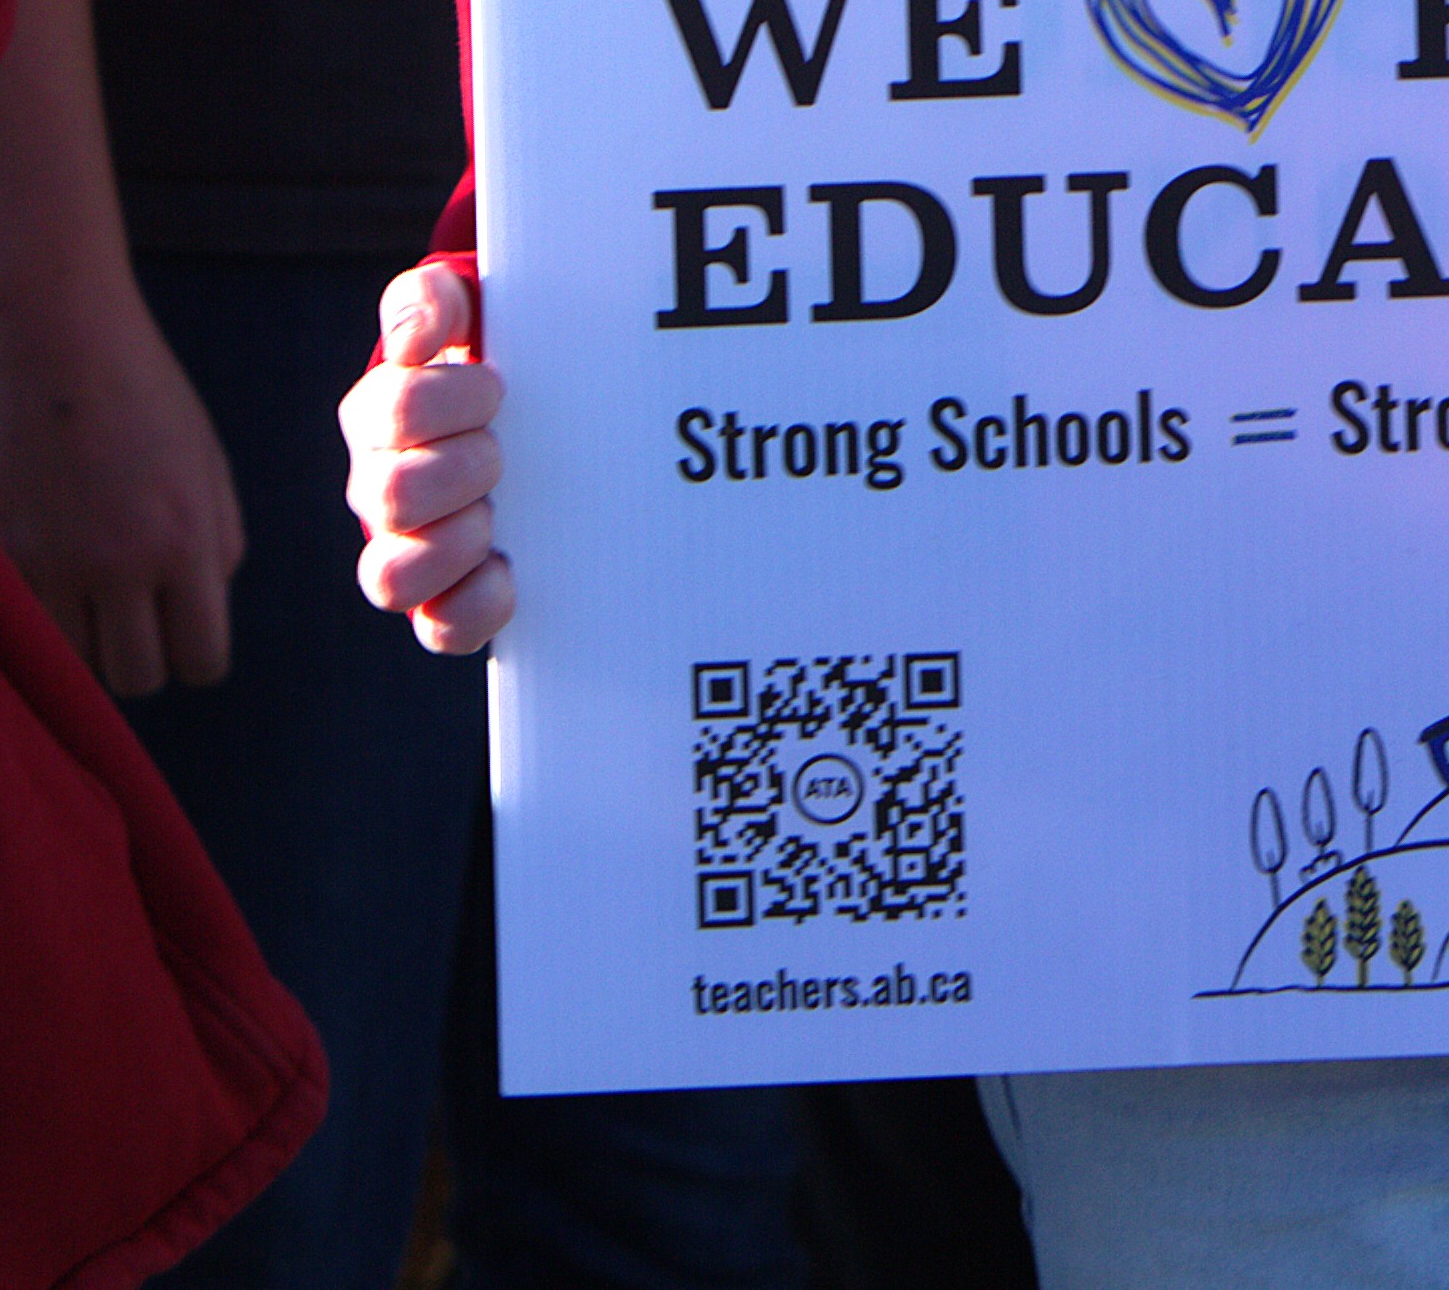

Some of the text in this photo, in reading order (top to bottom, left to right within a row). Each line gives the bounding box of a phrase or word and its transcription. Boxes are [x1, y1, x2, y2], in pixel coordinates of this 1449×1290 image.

[676, 407, 906, 491] Strong
[929, 389, 1191, 472] Schools
[1232, 409, 1296, 445] =
[802, 775, 852, 802] ATA
[691, 961, 973, 1016] teachers.ab.ca
